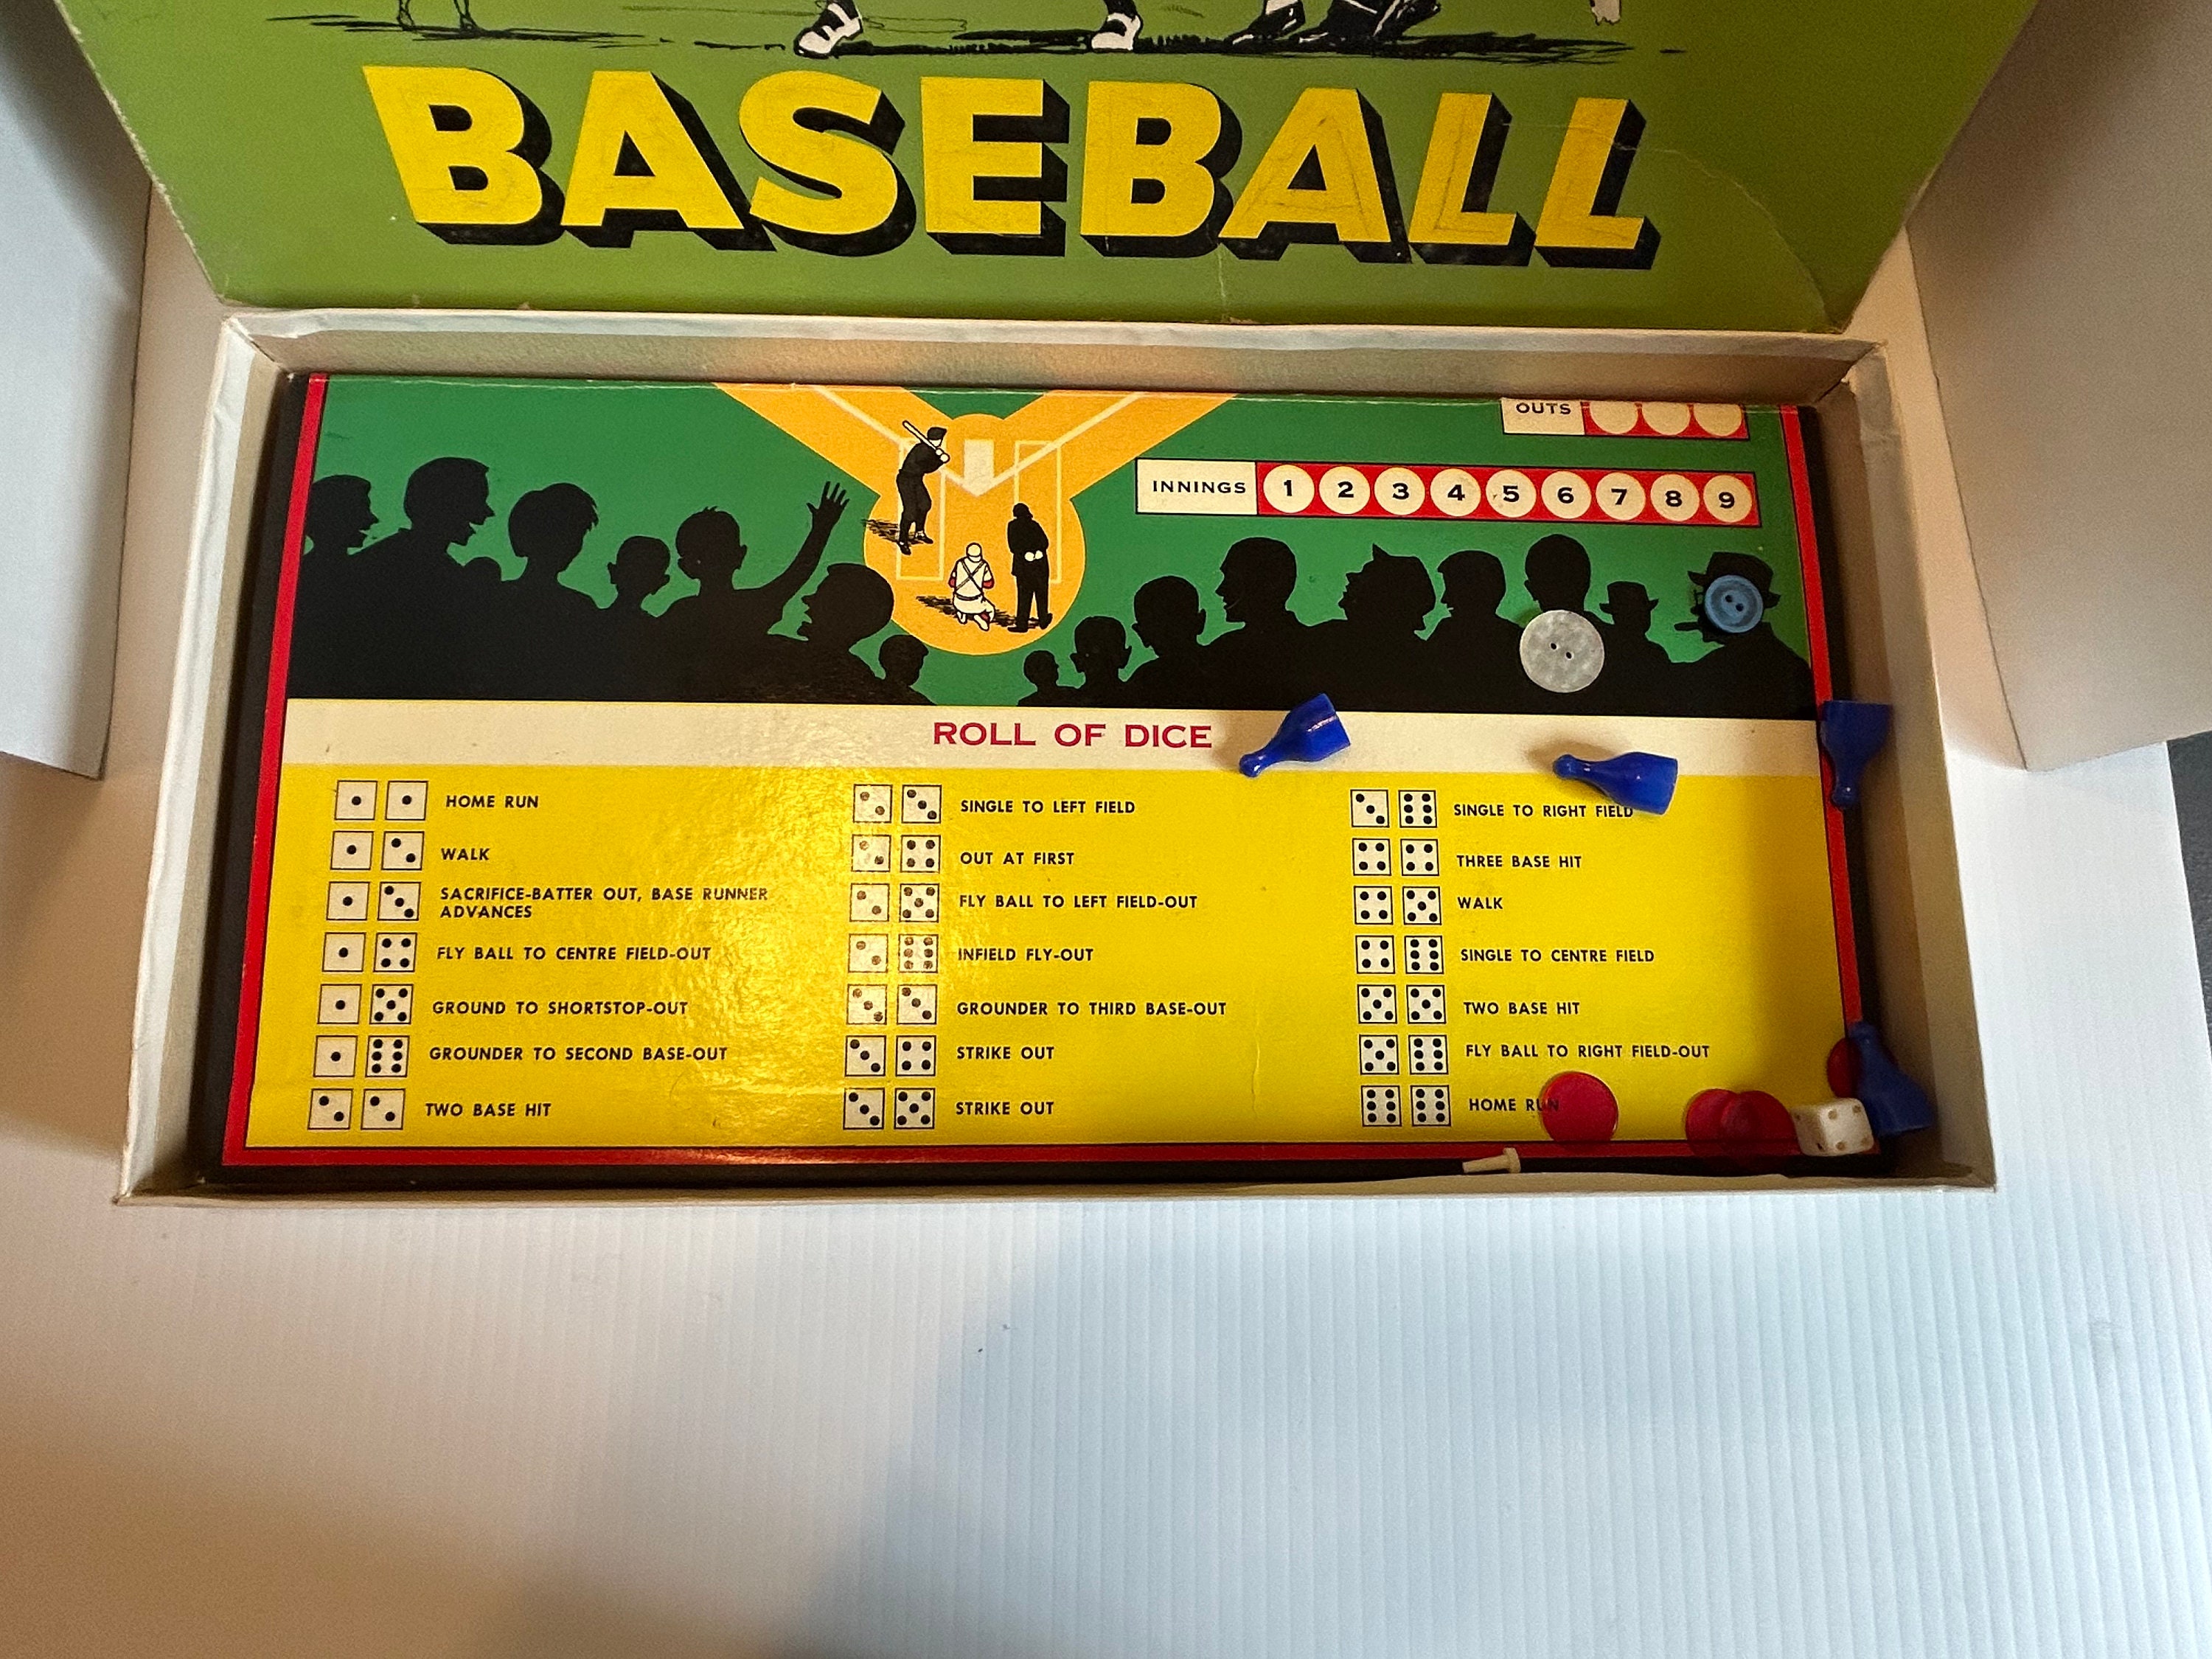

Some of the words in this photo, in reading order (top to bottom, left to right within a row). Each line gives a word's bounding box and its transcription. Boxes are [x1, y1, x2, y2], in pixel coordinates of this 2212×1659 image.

[362, 65, 1660, 270] BASEBALL
[1515, 402, 1572, 415] OUTS
[1152, 480, 1247, 494] INNINGS
[1283, 479, 1293, 497] 1
[1338, 481, 1354, 498] 2
[1391, 482, 1410, 500] 3
[1447, 484, 1466, 501] 4
[1502, 484, 1520, 503] 5
[1557, 487, 1574, 504] 6
[1610, 488, 1628, 506] 7
[1665, 490, 1683, 507] 8
[1718, 491, 1736, 509] 9
[933, 722, 1037, 746] ROLL
[1054, 723, 1107, 747] OF
[1124, 724, 1212, 748] DICE
[445, 795, 495, 808] HOME
[504, 795, 539, 809] RUN
[961, 799, 1013, 813] SINGLE
[1022, 800, 1043, 813] TO
[1053, 800, 1086, 813] LEFT
[1095, 801, 1135, 814] FIELD
[1453, 804, 1504, 816] SINGLE
[1512, 804, 1534, 817] TO
[1543, 804, 1587, 818] RIGHT
[1596, 804, 1634, 818] FIELD
[441, 848, 490, 860] WALK
[960, 852, 993, 865] OUT
[1003, 852, 1024, 865] AT
[1034, 852, 1074, 865] FIRST
[1456, 855, 1503, 868] THREE
[1512, 855, 1550, 868] BASE
[1559, 855, 1582, 868] HIT
[440, 887, 593, 901] SACRIFICE-BATTER
[603, 887, 642, 902] OUT,
[651, 887, 693, 901] BASE
[703, 887, 768, 901] RUNNER
[959, 894, 987, 908] FLY
[995, 894, 1034, 908] BALL
[1043, 895, 1065, 908] TO
[1074, 895, 1107, 908] LEFT
[1116, 895, 1197, 908] FIELD-OUT
[1457, 897, 1503, 910] WALK
[439, 905, 532, 919] ADVANCES
[437, 946, 465, 960] FLY
[474, 947, 514, 960] BALL
[524, 947, 546, 960] TO
[556, 947, 616, 960] CENTRE
[626, 947, 712, 960] FIELD-OUT
[958, 947, 1016, 961] INFIELD
[1026, 948, 1094, 961] FLY-OUT
[1461, 948, 1512, 961] SINGLE
[1520, 949, 1542, 961] TO
[1551, 949, 1607, 962] CENTRE
[1616, 949, 1655, 962] FIELD
[432, 1001, 506, 1015] GROUND
[515, 1001, 538, 1015] TO
[548, 1001, 688, 1015] SHORTSTOP-OUT
[957, 1002, 1048, 1015] GROUNDER
[1057, 1002, 1079, 1015] TO
[1088, 1001, 1136, 1015] THIRD
[1146, 1001, 1227, 1015] BASE-OUT
[1463, 1001, 1499, 1015] TWO
[1509, 1002, 1548, 1015] BASE
[1557, 1001, 1580, 1015] HIT
[429, 1046, 523, 1061] GROUNDER
[533, 1047, 556, 1061] TO
[565, 1047, 633, 1061] SECOND
[643, 1046, 728, 1061] BASE-OUT
[957, 1046, 1011, 1060] STRIKE
[1020, 1046, 1054, 1060] OUT
[1466, 1043, 1492, 1057] FLY
[1501, 1044, 1539, 1057] BALL
[1547, 1044, 1568, 1057] TO
[1578, 1044, 1623, 1058] RIGHT
[1632, 1045, 1710, 1058] FIELD-OUT
[425, 1102, 463, 1117] TWO
[473, 1103, 515, 1117] BASE
[525, 1102, 552, 1117] HIT
[956, 1102, 1010, 1116] STRIKE
[1020, 1102, 1054, 1116] OUT
[1469, 1098, 1517, 1112] HOME
